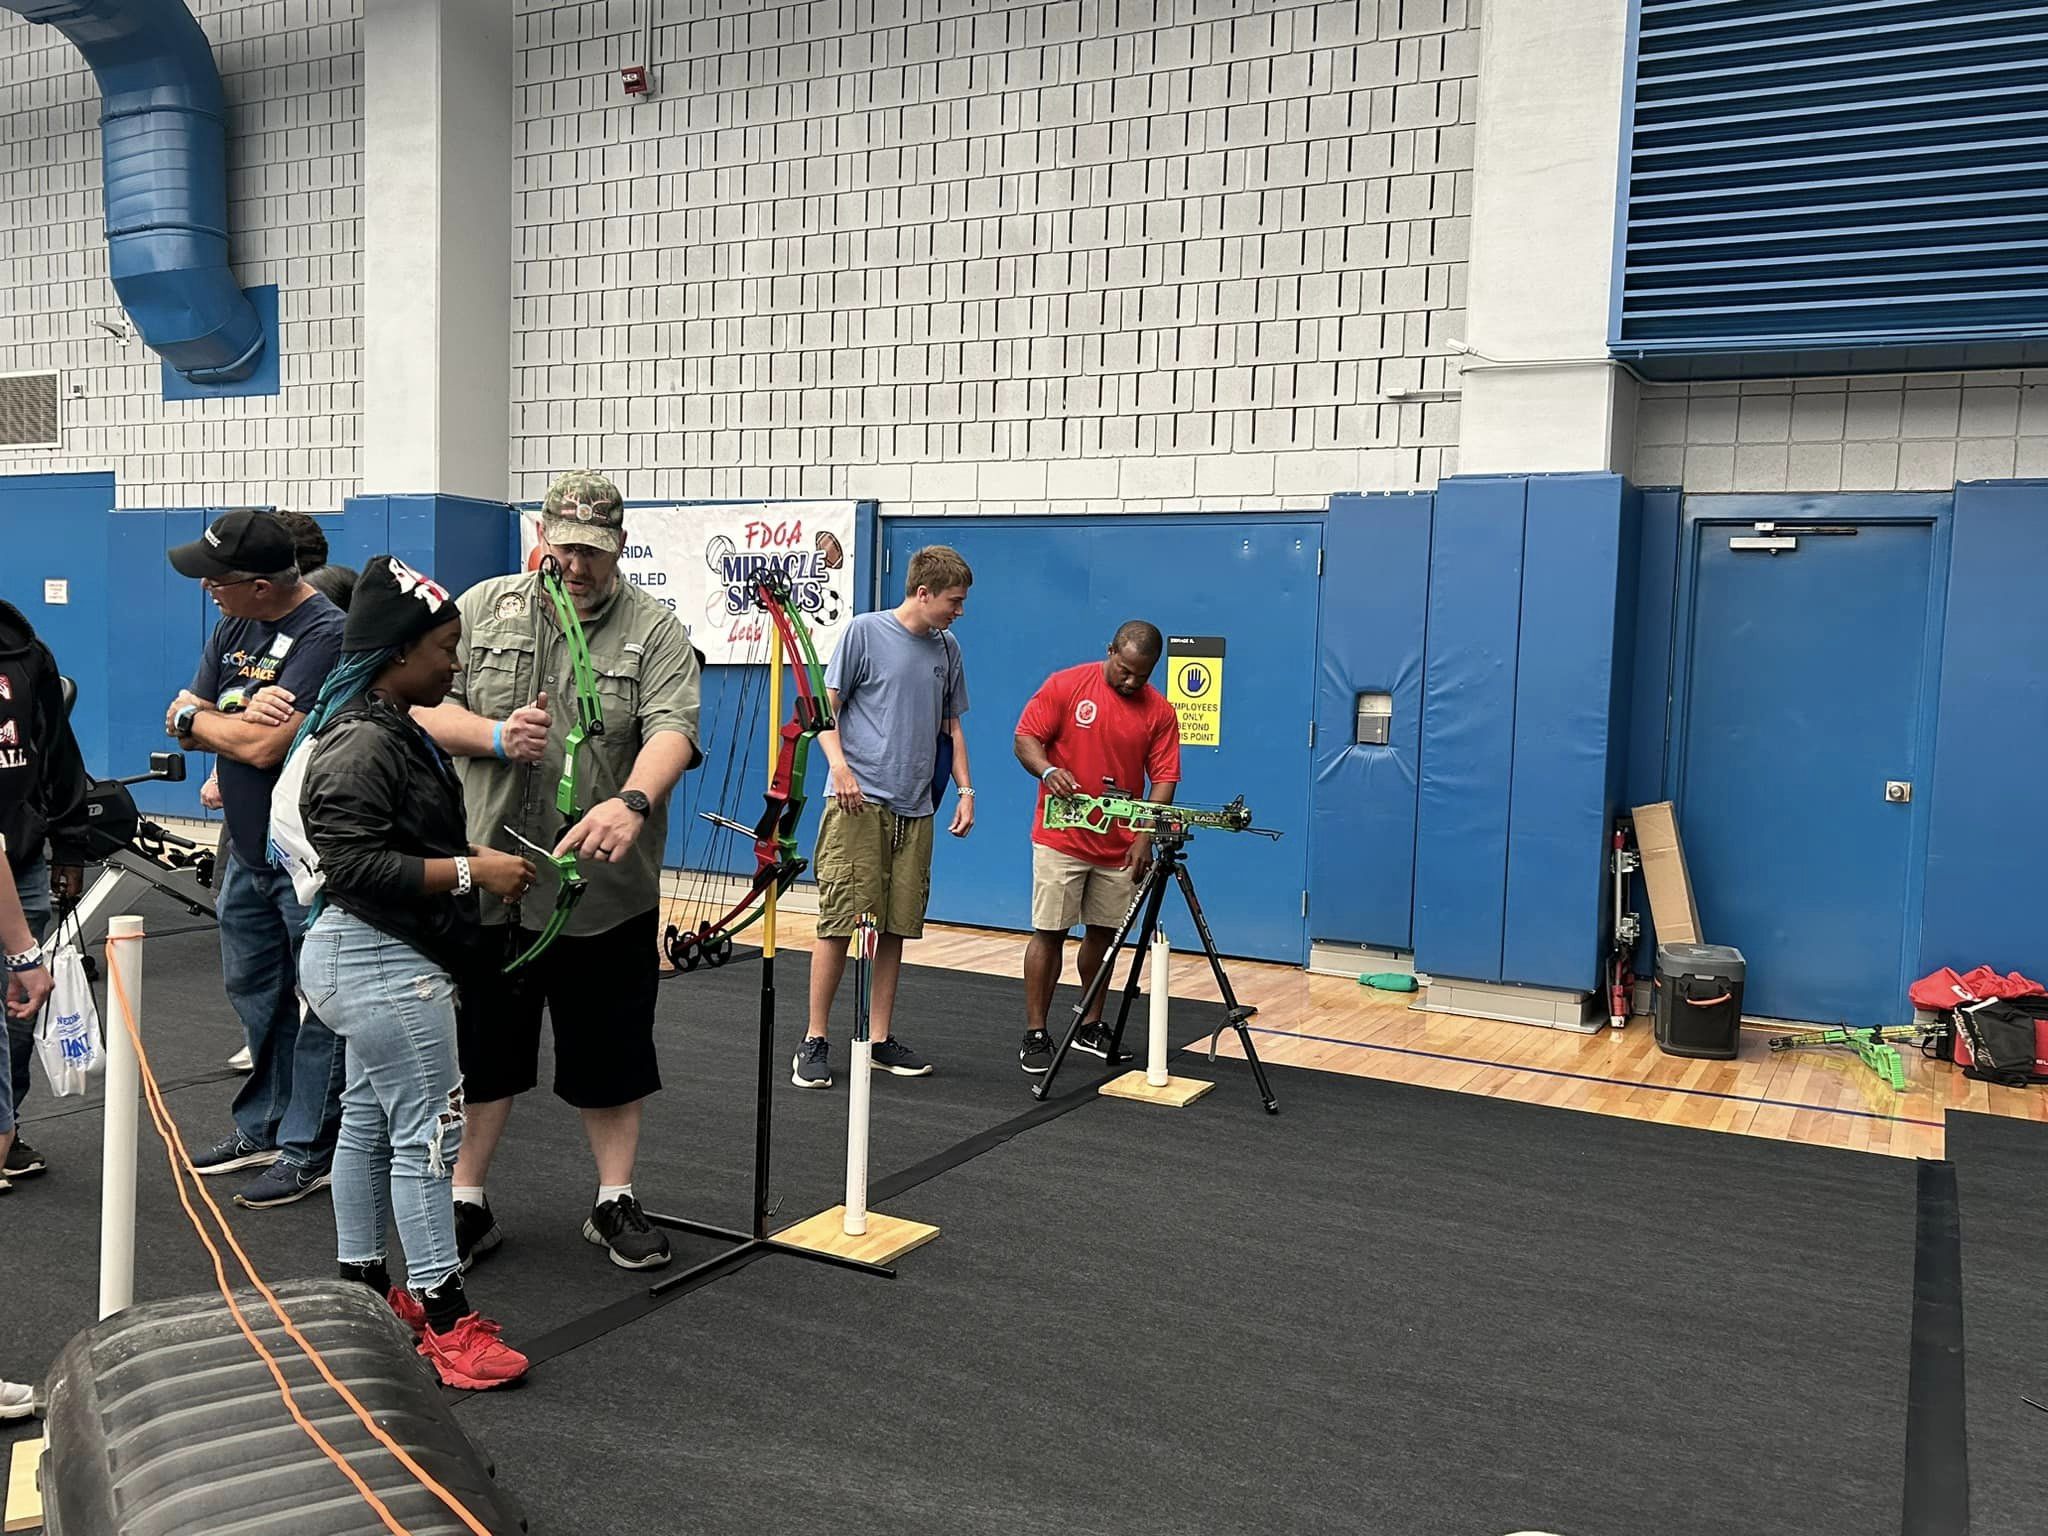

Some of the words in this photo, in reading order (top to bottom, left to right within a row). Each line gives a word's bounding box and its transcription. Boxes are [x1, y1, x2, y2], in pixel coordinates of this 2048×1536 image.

[745, 520, 802, 549] FDOA
[621, 545, 653, 558] RIDA
[721, 551, 828, 583] MIRACLE
[624, 572, 667, 585] BLED
[1172, 702, 1218, 712] MPLOYEES
[1182, 712, 1204, 721] ONLY
[1190, 733, 1215, 741] POINT
